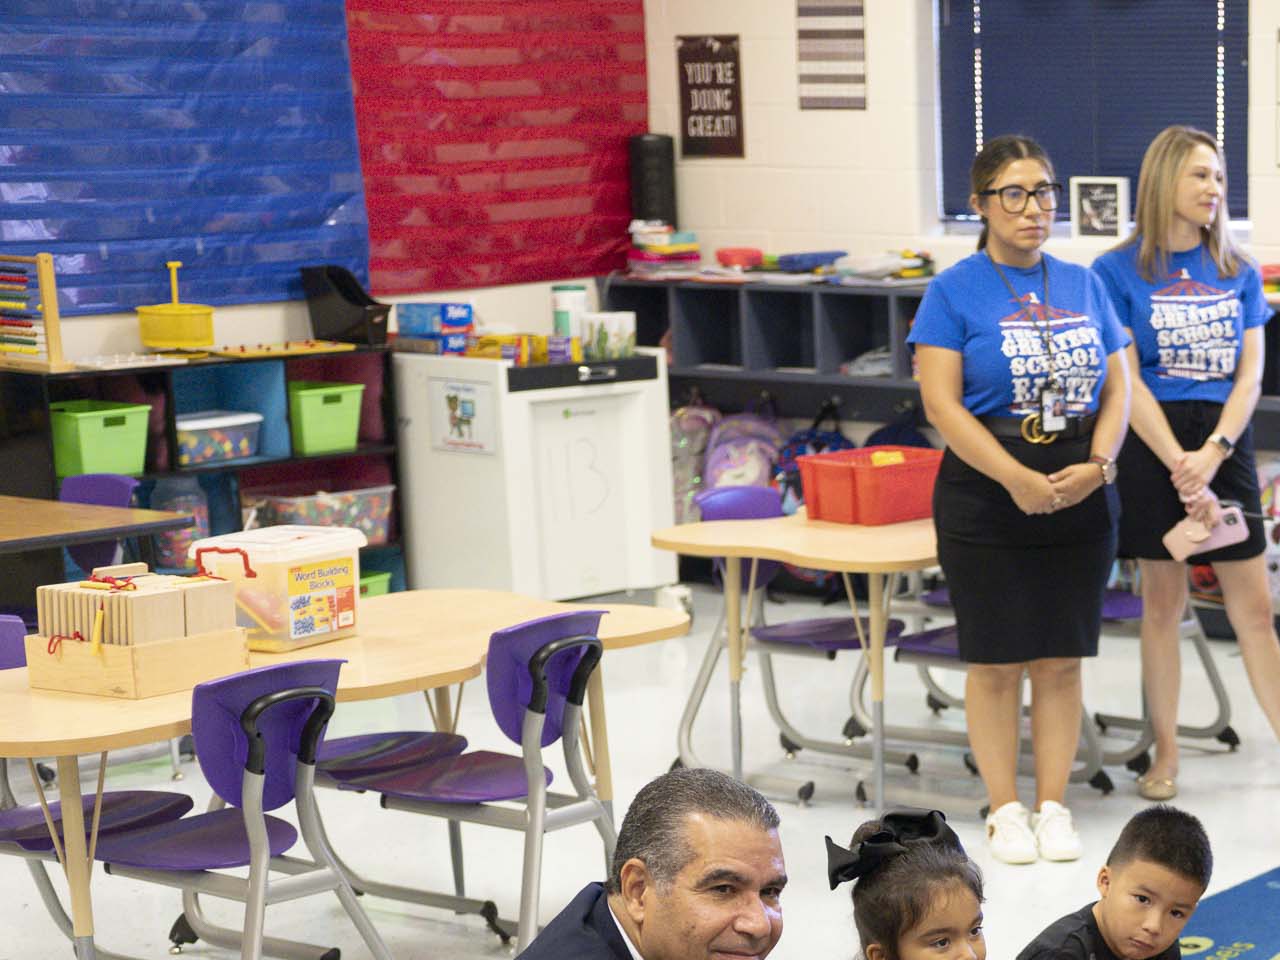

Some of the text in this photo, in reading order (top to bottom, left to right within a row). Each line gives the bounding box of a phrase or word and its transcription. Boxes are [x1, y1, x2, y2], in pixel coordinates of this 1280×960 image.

[684, 62, 736, 84] YOU'RE
[689, 88, 733, 111] DOING
[1150, 299, 1241, 330] GREATEST
[1157, 319, 1236, 347] SCHOOL
[1009, 347, 1101, 377] SCHOOL
[1158, 347, 1237, 374] EARTH
[295, 570, 316, 582] Word
[317, 566, 349, 578] Building
[309, 579, 336, 590] Blocks
